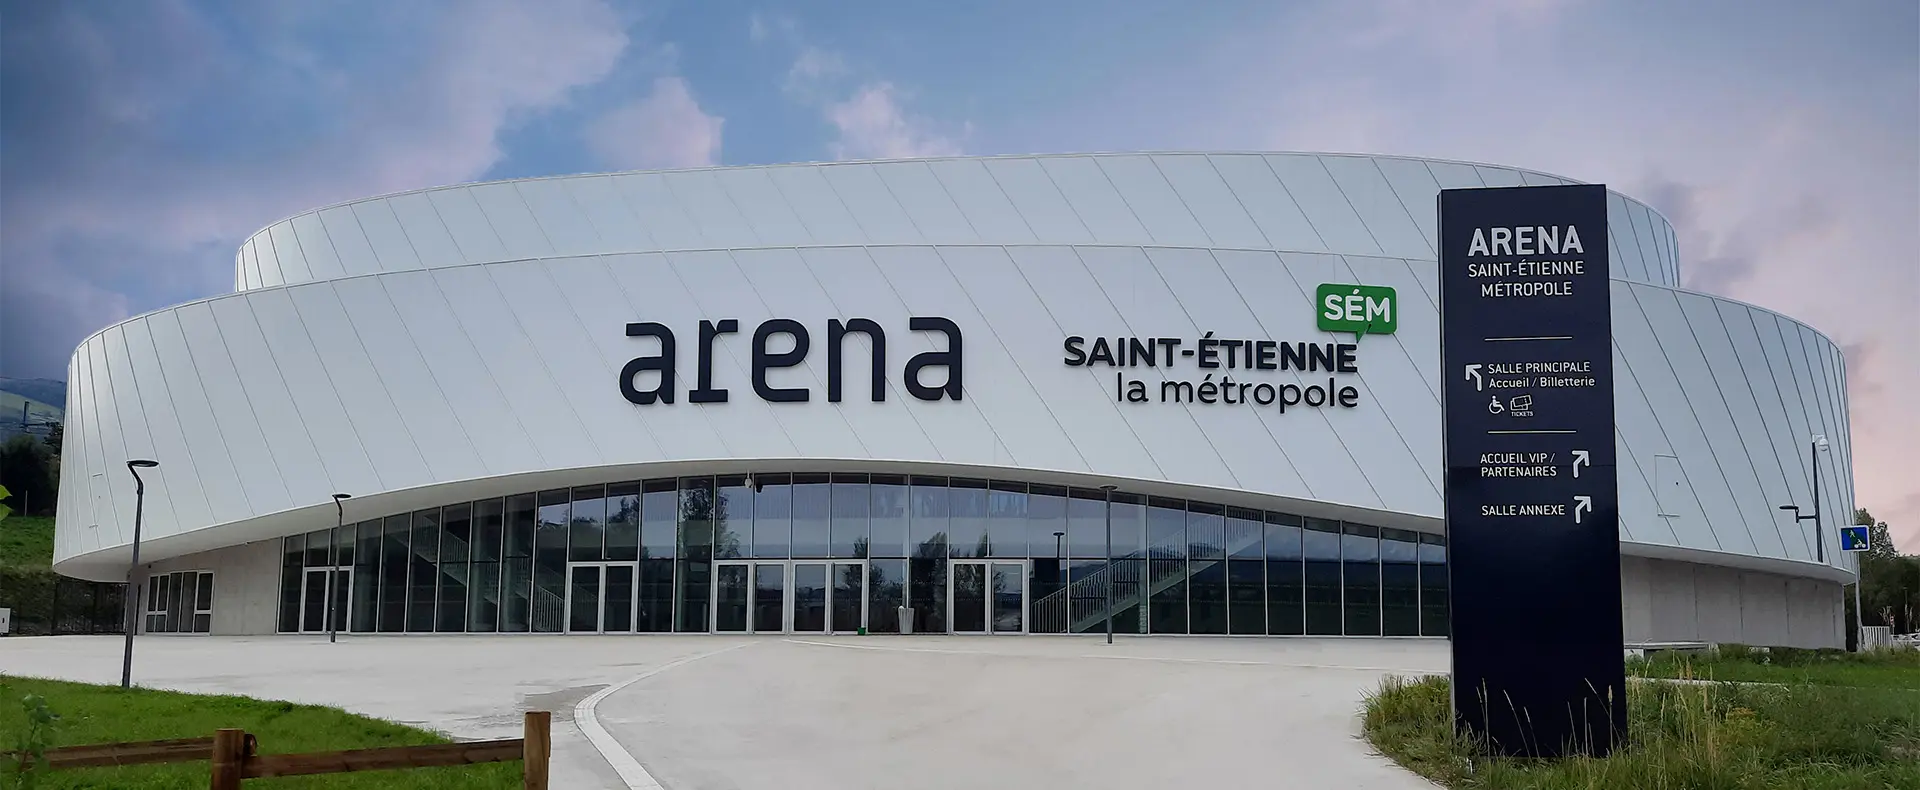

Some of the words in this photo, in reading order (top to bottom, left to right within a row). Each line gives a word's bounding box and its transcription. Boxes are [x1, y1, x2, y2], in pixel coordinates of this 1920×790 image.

[1467, 225, 1584, 257] ARENA
[1468, 259, 1585, 278] SAINT-ÉTIENNE
[1481, 281, 1573, 298] MÉTROPOLE
[1323, 288, 1391, 323] SÉM
[618, 316, 964, 405] arena
[1063, 331, 1359, 374] SAINT-ÉTIENNE
[1488, 363, 1523, 374] SALLE
[1525, 361, 1591, 373] PRINCIPALE
[1488, 377, 1530, 388] Accueil
[1531, 377, 1537, 387] /
[1540, 376, 1596, 387] Billetterie
[1117, 372, 1149, 403] la
[1160, 373, 1359, 414] métropole
[1480, 453, 1527, 464] ACCUEIL
[1528, 453, 1548, 463] VIP
[1549, 453, 1556, 463] /
[1481, 466, 1557, 477] PARTENAIRES
[1481, 505, 1517, 516] SALLE
[1519, 504, 1566, 516] ANNEXE
